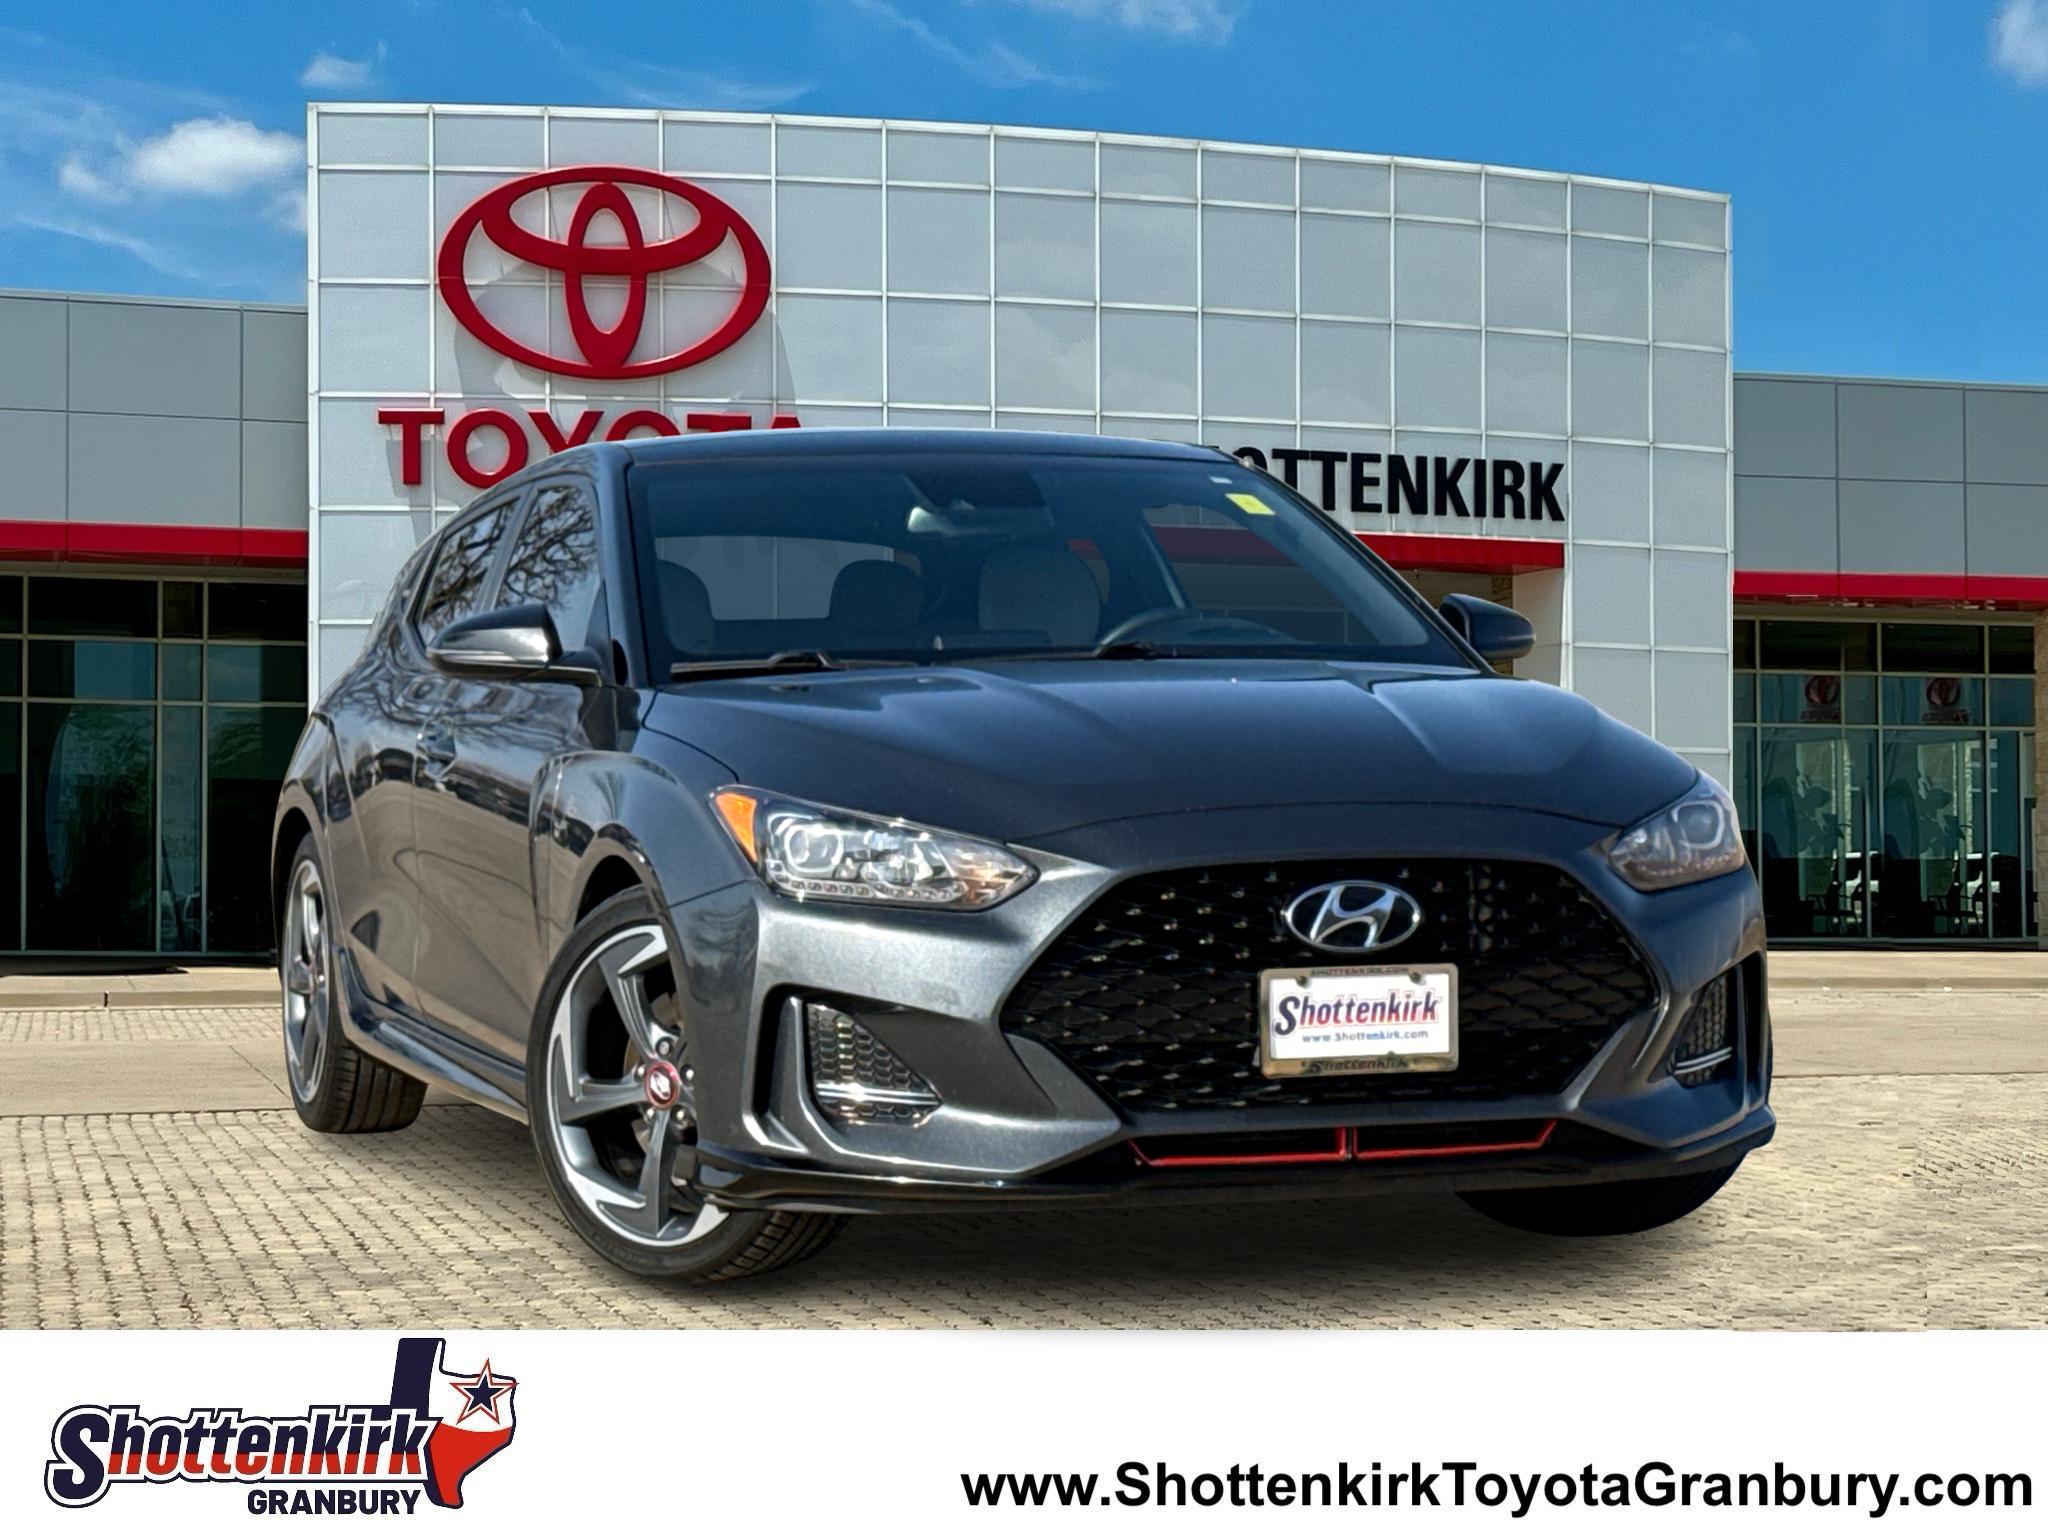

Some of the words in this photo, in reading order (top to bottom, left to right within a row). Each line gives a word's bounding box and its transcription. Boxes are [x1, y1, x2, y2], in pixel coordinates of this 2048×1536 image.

[377, 407, 802, 488] TOY
[1206, 445, 1565, 522] TTENKIRK
[1274, 988, 1440, 1036] Shottenkirk
[1301, 1029, 1429, 1043] www.Shottenkirk.com
